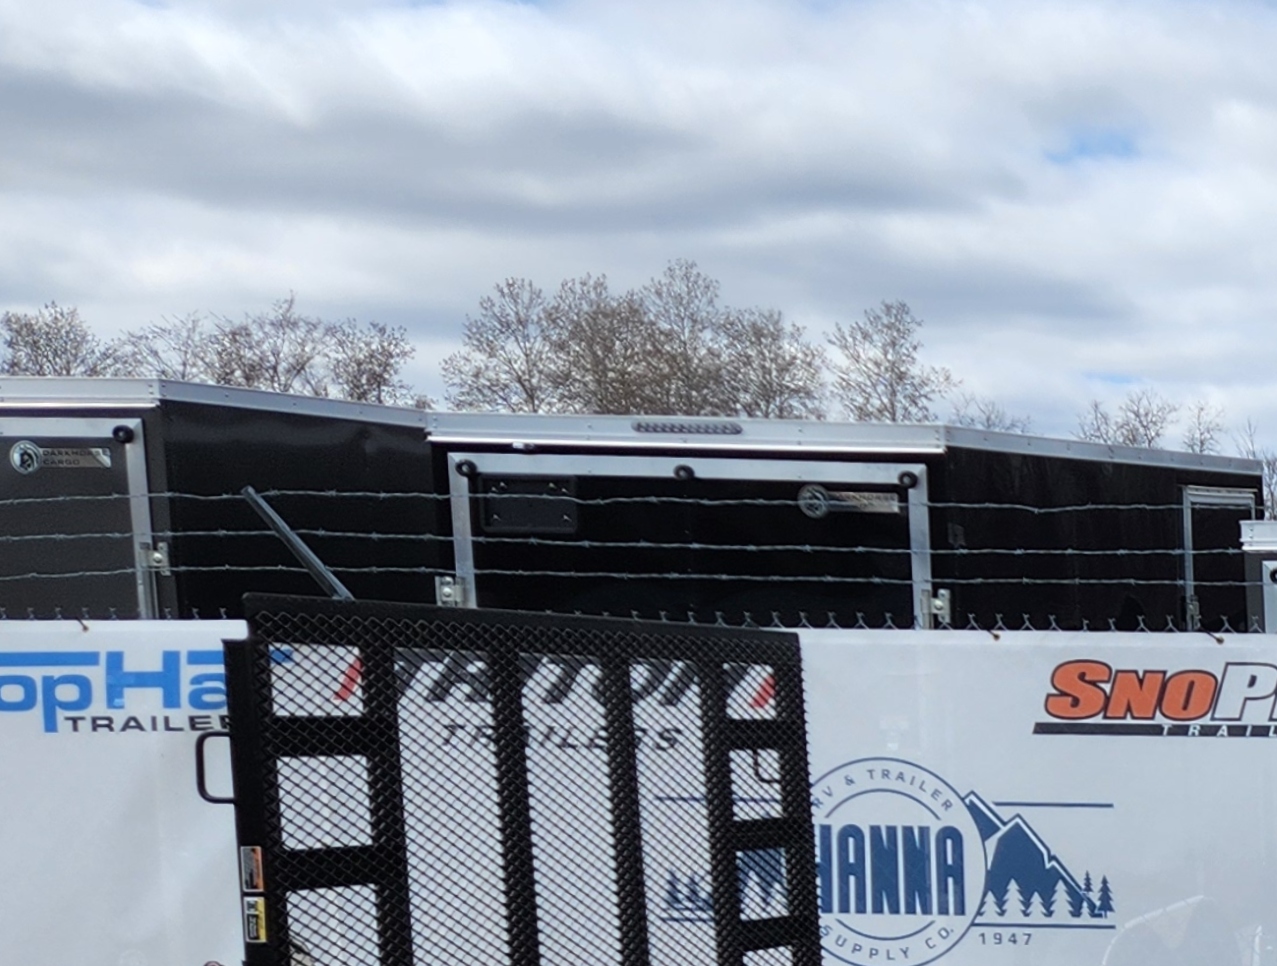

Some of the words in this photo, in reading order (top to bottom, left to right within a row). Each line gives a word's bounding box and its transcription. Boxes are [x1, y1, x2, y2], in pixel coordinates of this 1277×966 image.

[843, 774, 856, 786] &
[866, 767, 954, 812] TRAILER
[819, 923, 910, 961] SUPPLY
[925, 926, 955, 949] CO.
[978, 932, 1033, 946] 1947
